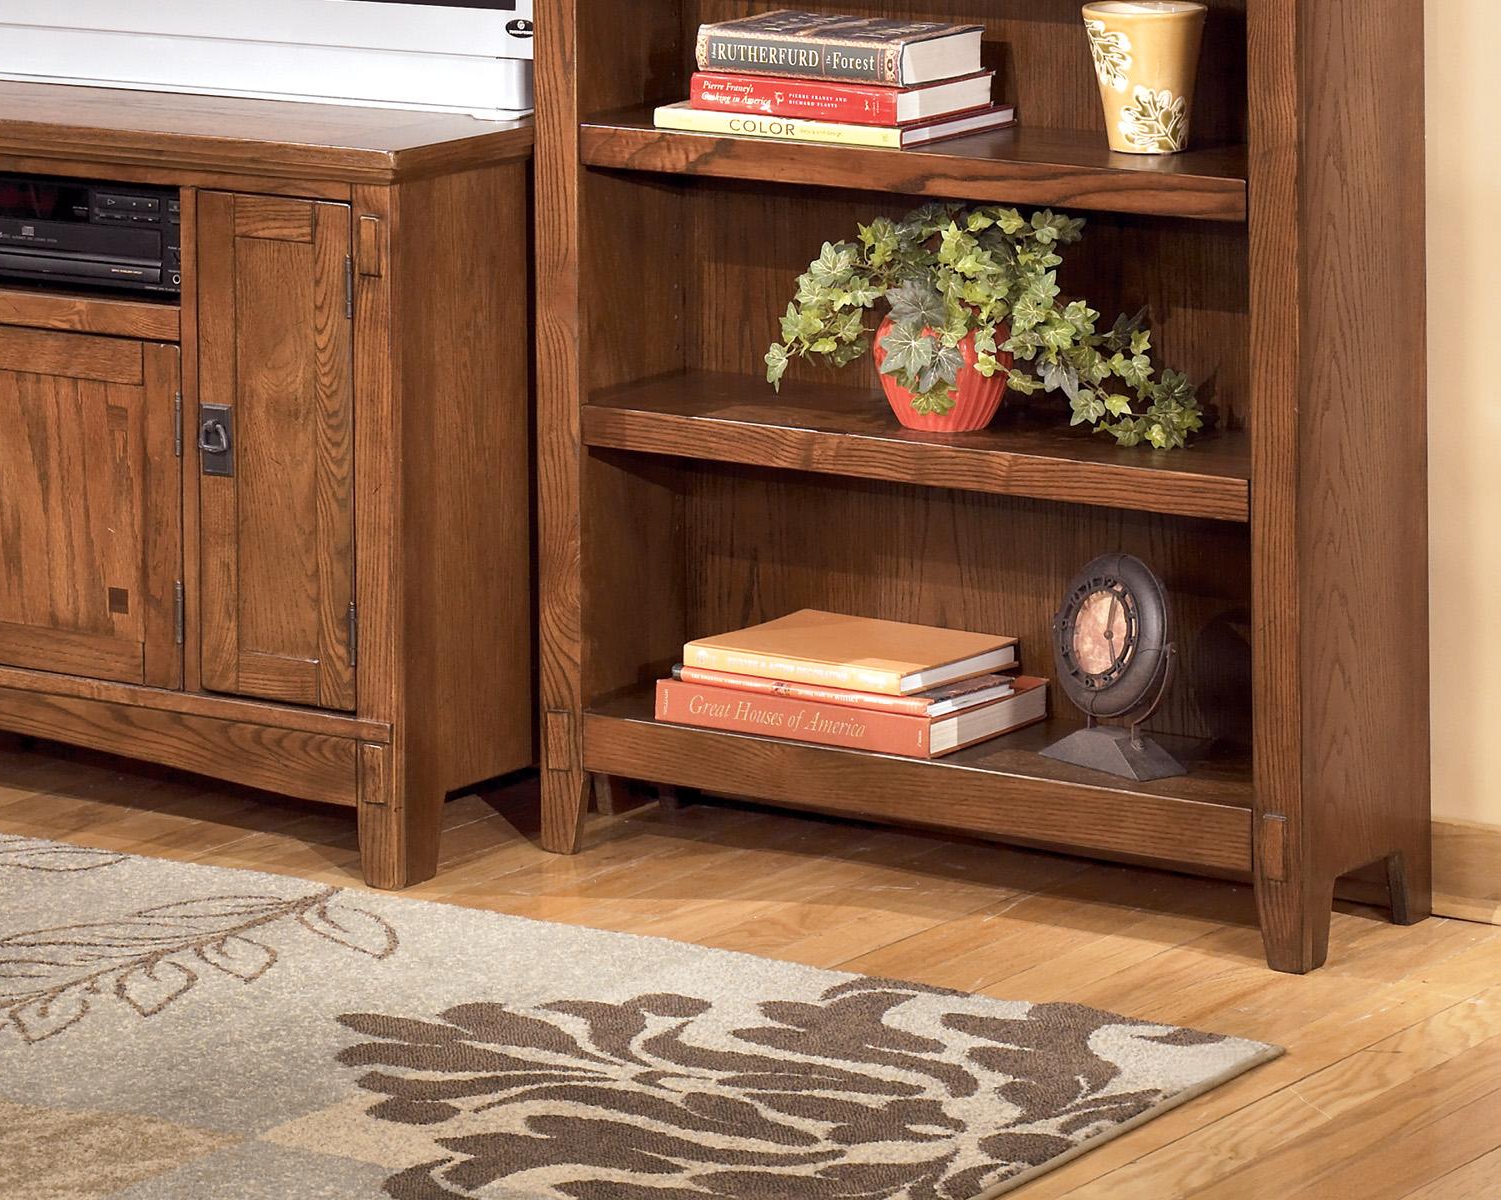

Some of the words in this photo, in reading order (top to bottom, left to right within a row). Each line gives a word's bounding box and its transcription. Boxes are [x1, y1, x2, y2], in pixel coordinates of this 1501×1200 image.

[718, 43, 819, 67] RUTHERFURD
[833, 52, 875, 71] Forest
[703, 81, 725, 91] Pierre
[732, 94, 740, 102] in
[741, 95, 771, 106] America
[729, 119, 795, 136] COLOR
[689, 695, 731, 717] Great
[734, 701, 783, 726] Houses
[787, 712, 804, 732] of
[804, 713, 866, 738] America
